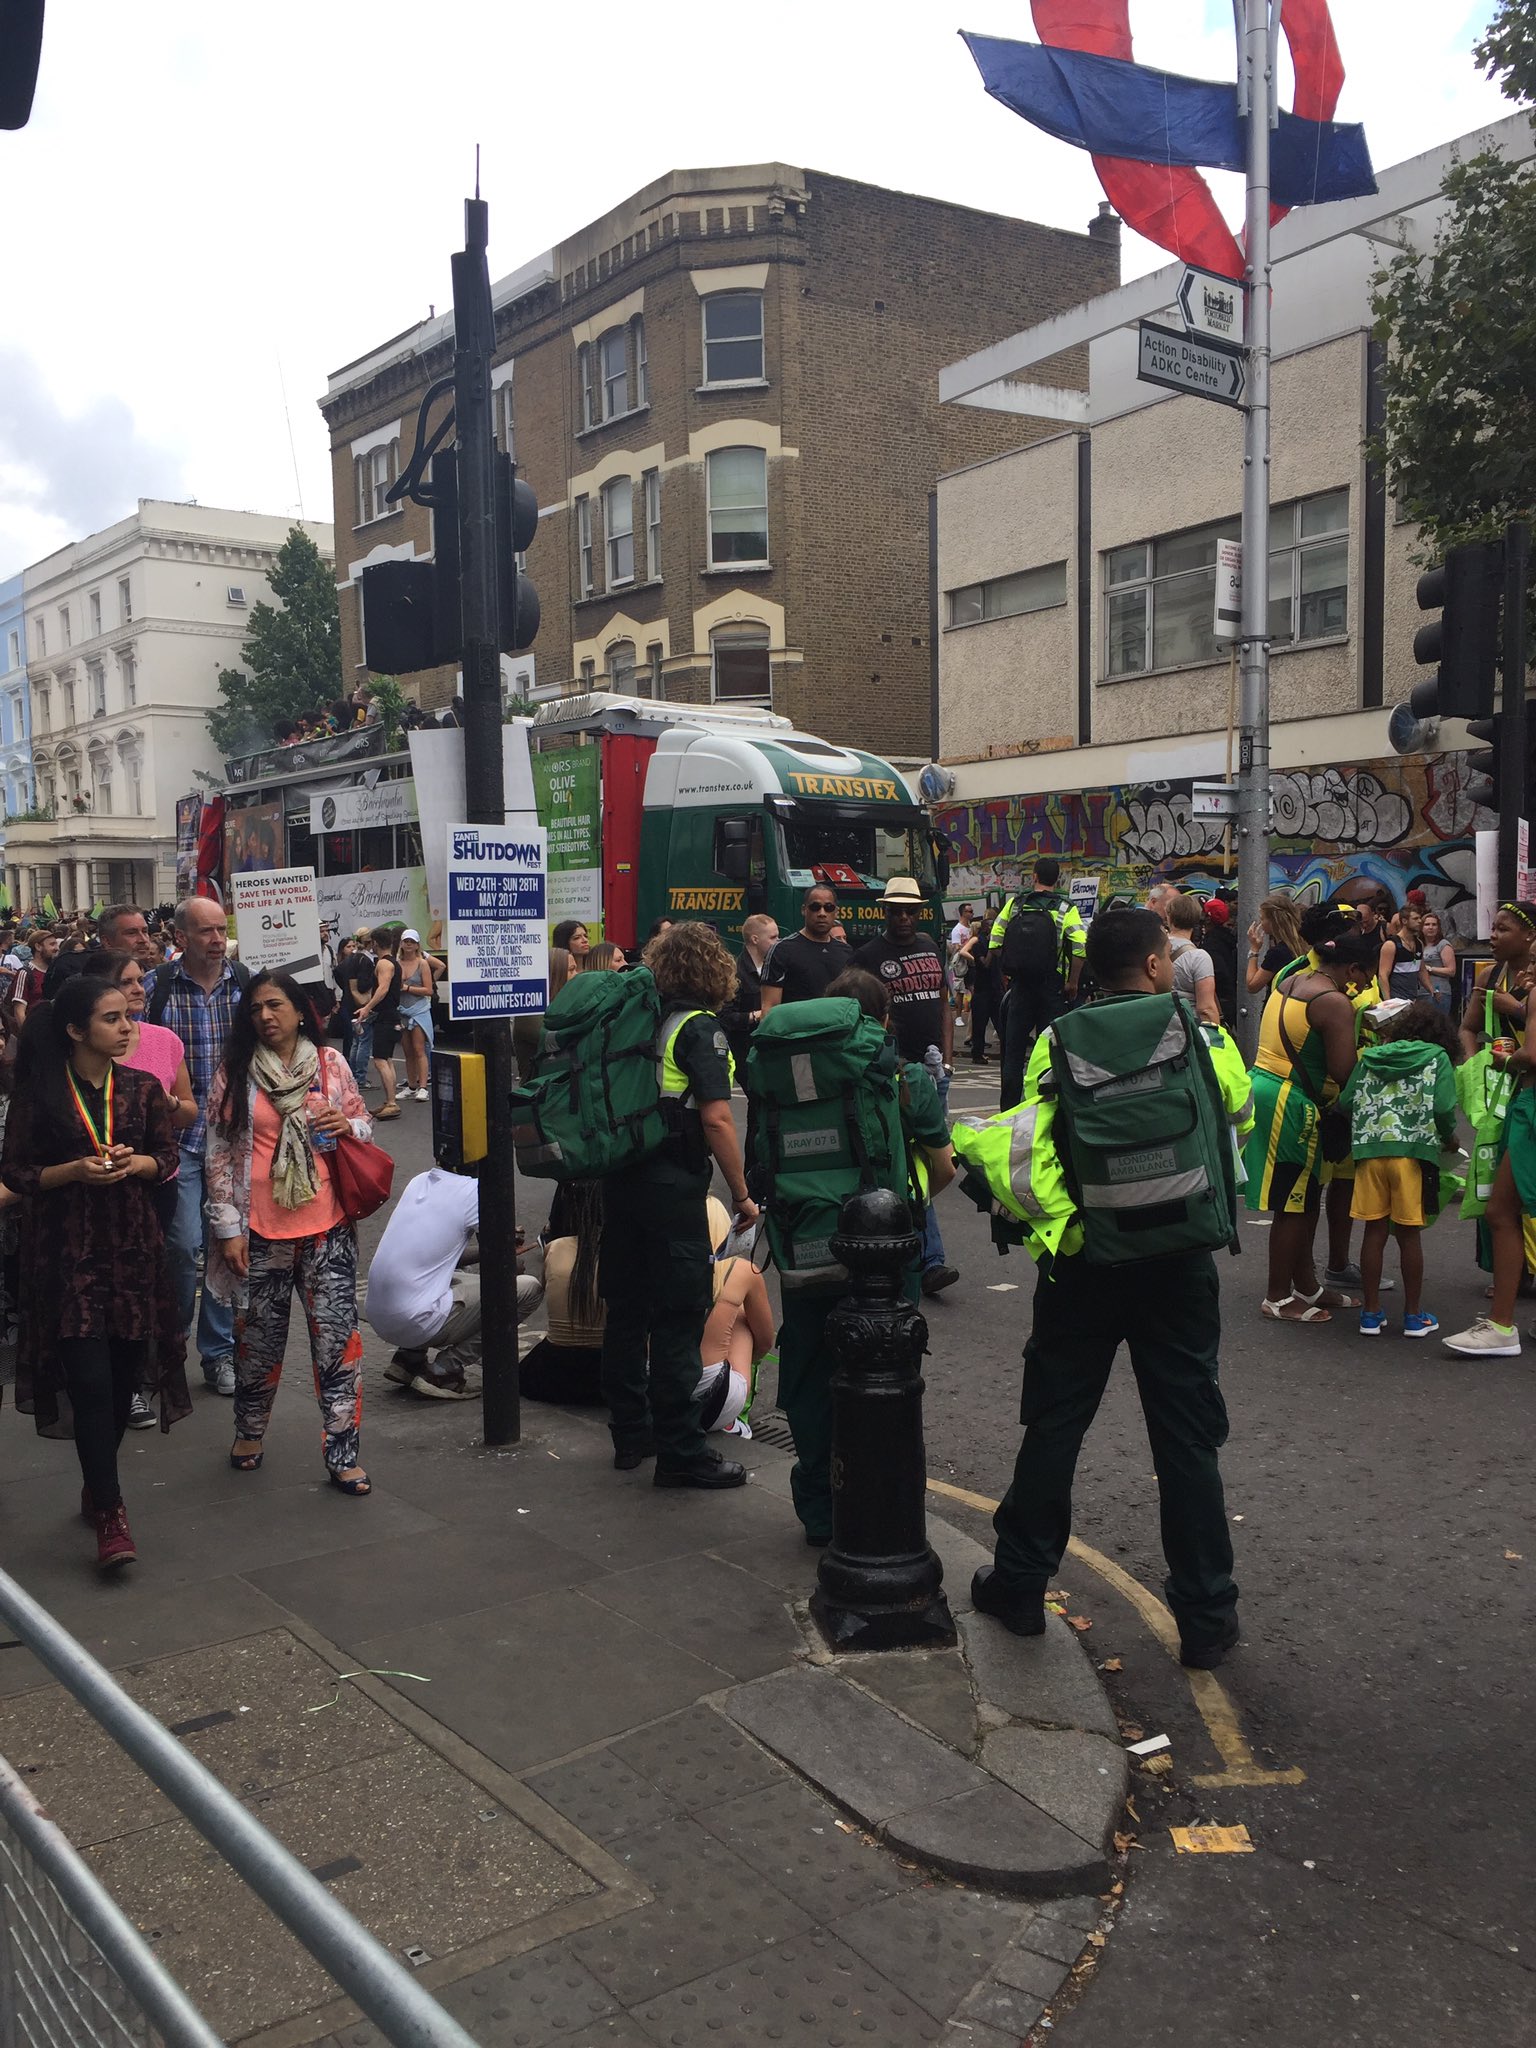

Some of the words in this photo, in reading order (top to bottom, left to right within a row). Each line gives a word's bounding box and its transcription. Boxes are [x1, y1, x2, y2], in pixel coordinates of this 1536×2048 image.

[1204, 307, 1233, 323] PORTOBELLO
[1207, 318, 1230, 332] MARKET
[1144, 335, 1177, 357] Action
[1181, 347, 1226, 375] Disability
[1151, 355, 1181, 375] ADKC
[1185, 366, 1218, 387] Centre
[552, 760, 571, 773] ORS
[550, 775, 576, 790] OLIVE
[678, 780, 754, 794] www.transtex.co.uk
[788, 772, 900, 800] TRANSTEX
[552, 791, 568, 804] OIL
[551, 816, 576, 828] BEAUTIFUL
[578, 814, 590, 825] HAIR
[454, 832, 478, 841] ZANTE
[564, 829, 572, 840] ALL
[454, 841, 540, 865] SHUTDOWN
[236, 878, 270, 888] HEROES
[272, 874, 312, 884] WANTED!
[836, 870, 852, 882] 2
[456, 876, 474, 891] WED
[476, 877, 496, 891] 24TH
[502, 878, 518, 891] SUN
[519, 878, 538, 891] 28TH
[240, 890, 260, 899] SAVE
[262, 889, 276, 897] THE
[278, 886, 311, 894] WORLD,
[479, 892, 498, 906] MAY
[498, 892, 518, 906] 2017
[668, 888, 746, 910] TRANSTEX
[236, 902, 255, 910] ONE
[295, 895, 316, 903] TIME.
[458, 909, 472, 917] BANK
[474, 909, 496, 917] HOLIDAY
[498, 908, 537, 916] EXTRAVAGANZA
[472, 924, 484, 934] NON
[484, 924, 499, 934] STOP
[500, 924, 526, 934] PARTYING
[456, 936, 470, 946] POOL
[472, 935, 494, 946] PARTIES
[500, 934, 518, 944] BEACH
[520, 934, 541, 944] PARTIES
[477, 946, 485, 956] 35
[486, 946, 496, 956] DJS
[502, 946, 510, 956] 10
[510, 946, 522, 955] MCS
[466, 957, 510, 968] INTERNATIONAL
[510, 956, 532, 966] ARTISTS
[480, 968, 498, 978] ZANTE
[500, 968, 520, 978] GREECE
[488, 984, 502, 993] BOOK
[502, 984, 513, 992] NOW
[457, 992, 542, 1011] SHUTDOWNFEST.COM
[894, 994, 913, 1004] ONLY
[914, 992, 930, 1000] THE
[1297, 1104, 1314, 1144] JAMAICA
[787, 1138, 812, 1149] XRAY
[814, 1136, 826, 1146] 07
[830, 1135, 837, 1144] B
[1118, 1152, 1164, 1166] LONDON
[1110, 1158, 1175, 1177] AMBULANCE
